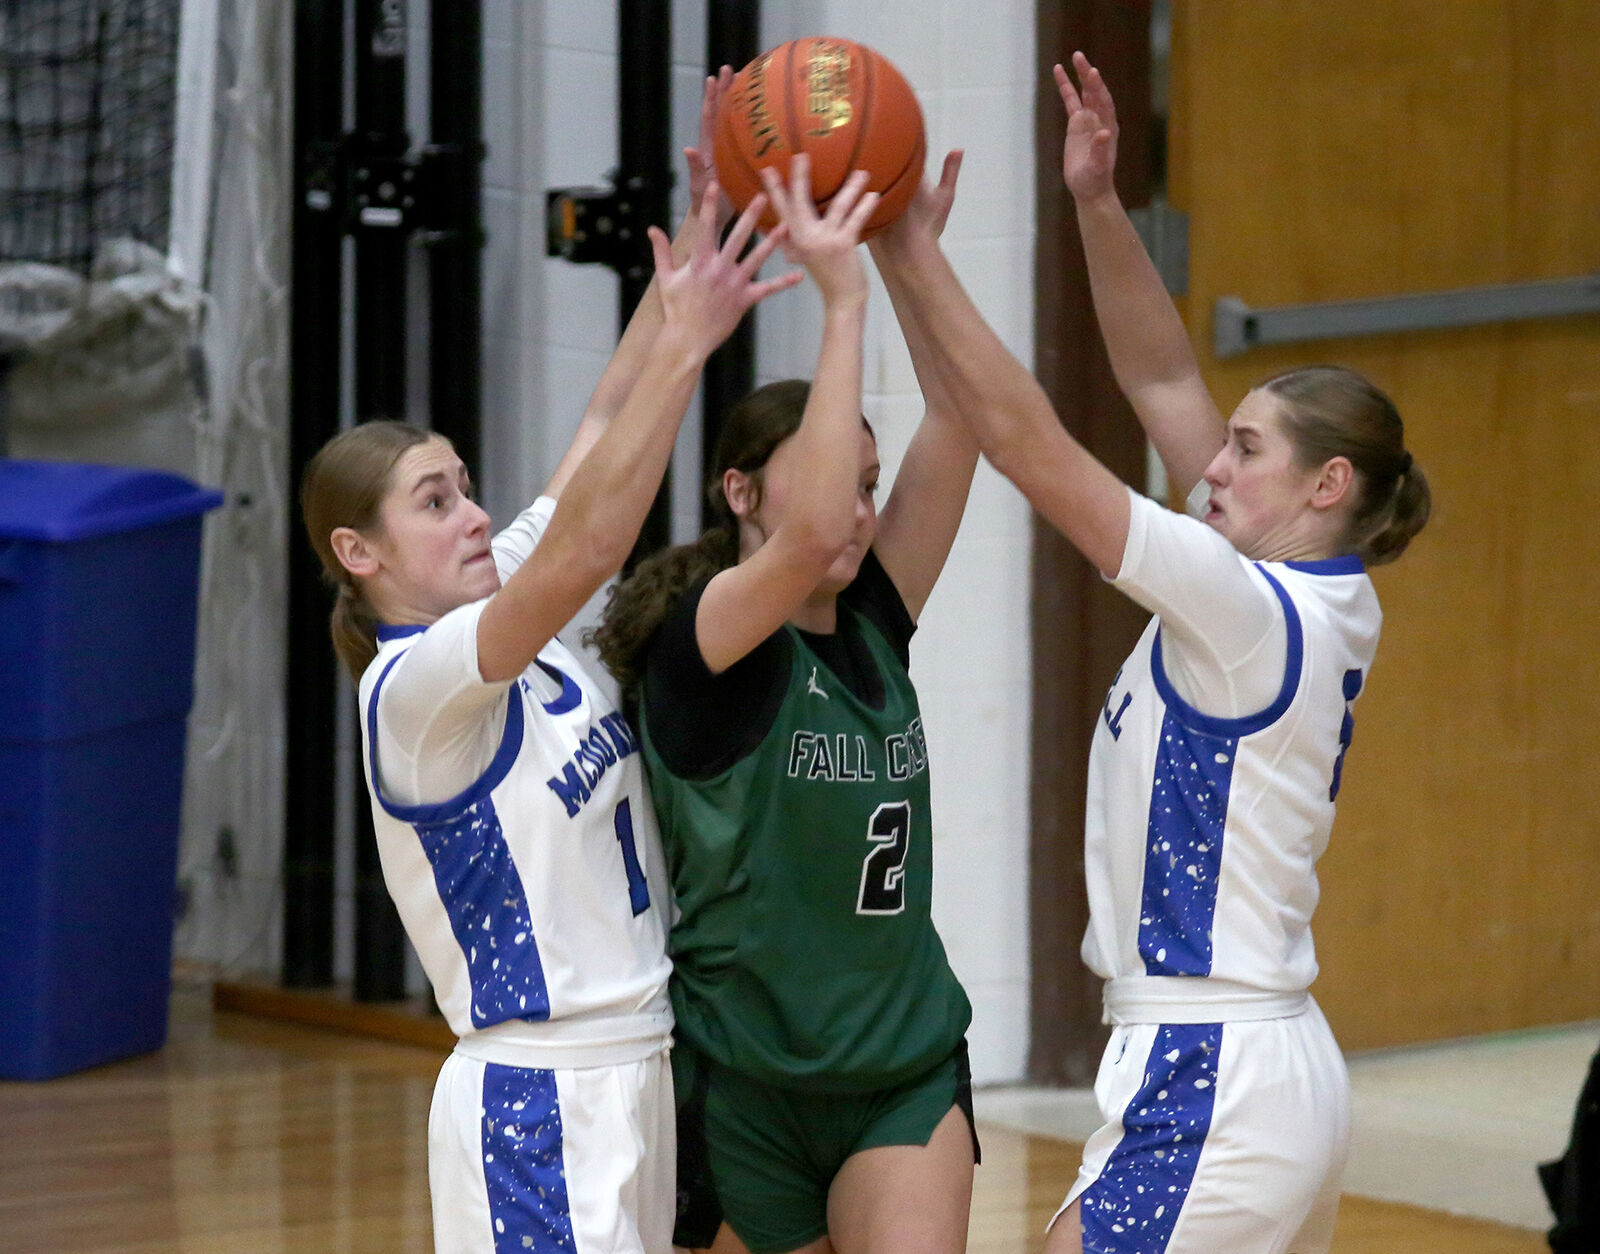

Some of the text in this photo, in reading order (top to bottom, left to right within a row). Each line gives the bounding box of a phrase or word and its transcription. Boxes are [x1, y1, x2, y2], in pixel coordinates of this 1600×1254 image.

[787, 729, 876, 782] FALL
[613, 795, 651, 919] 1
[855, 799, 911, 917] 2
